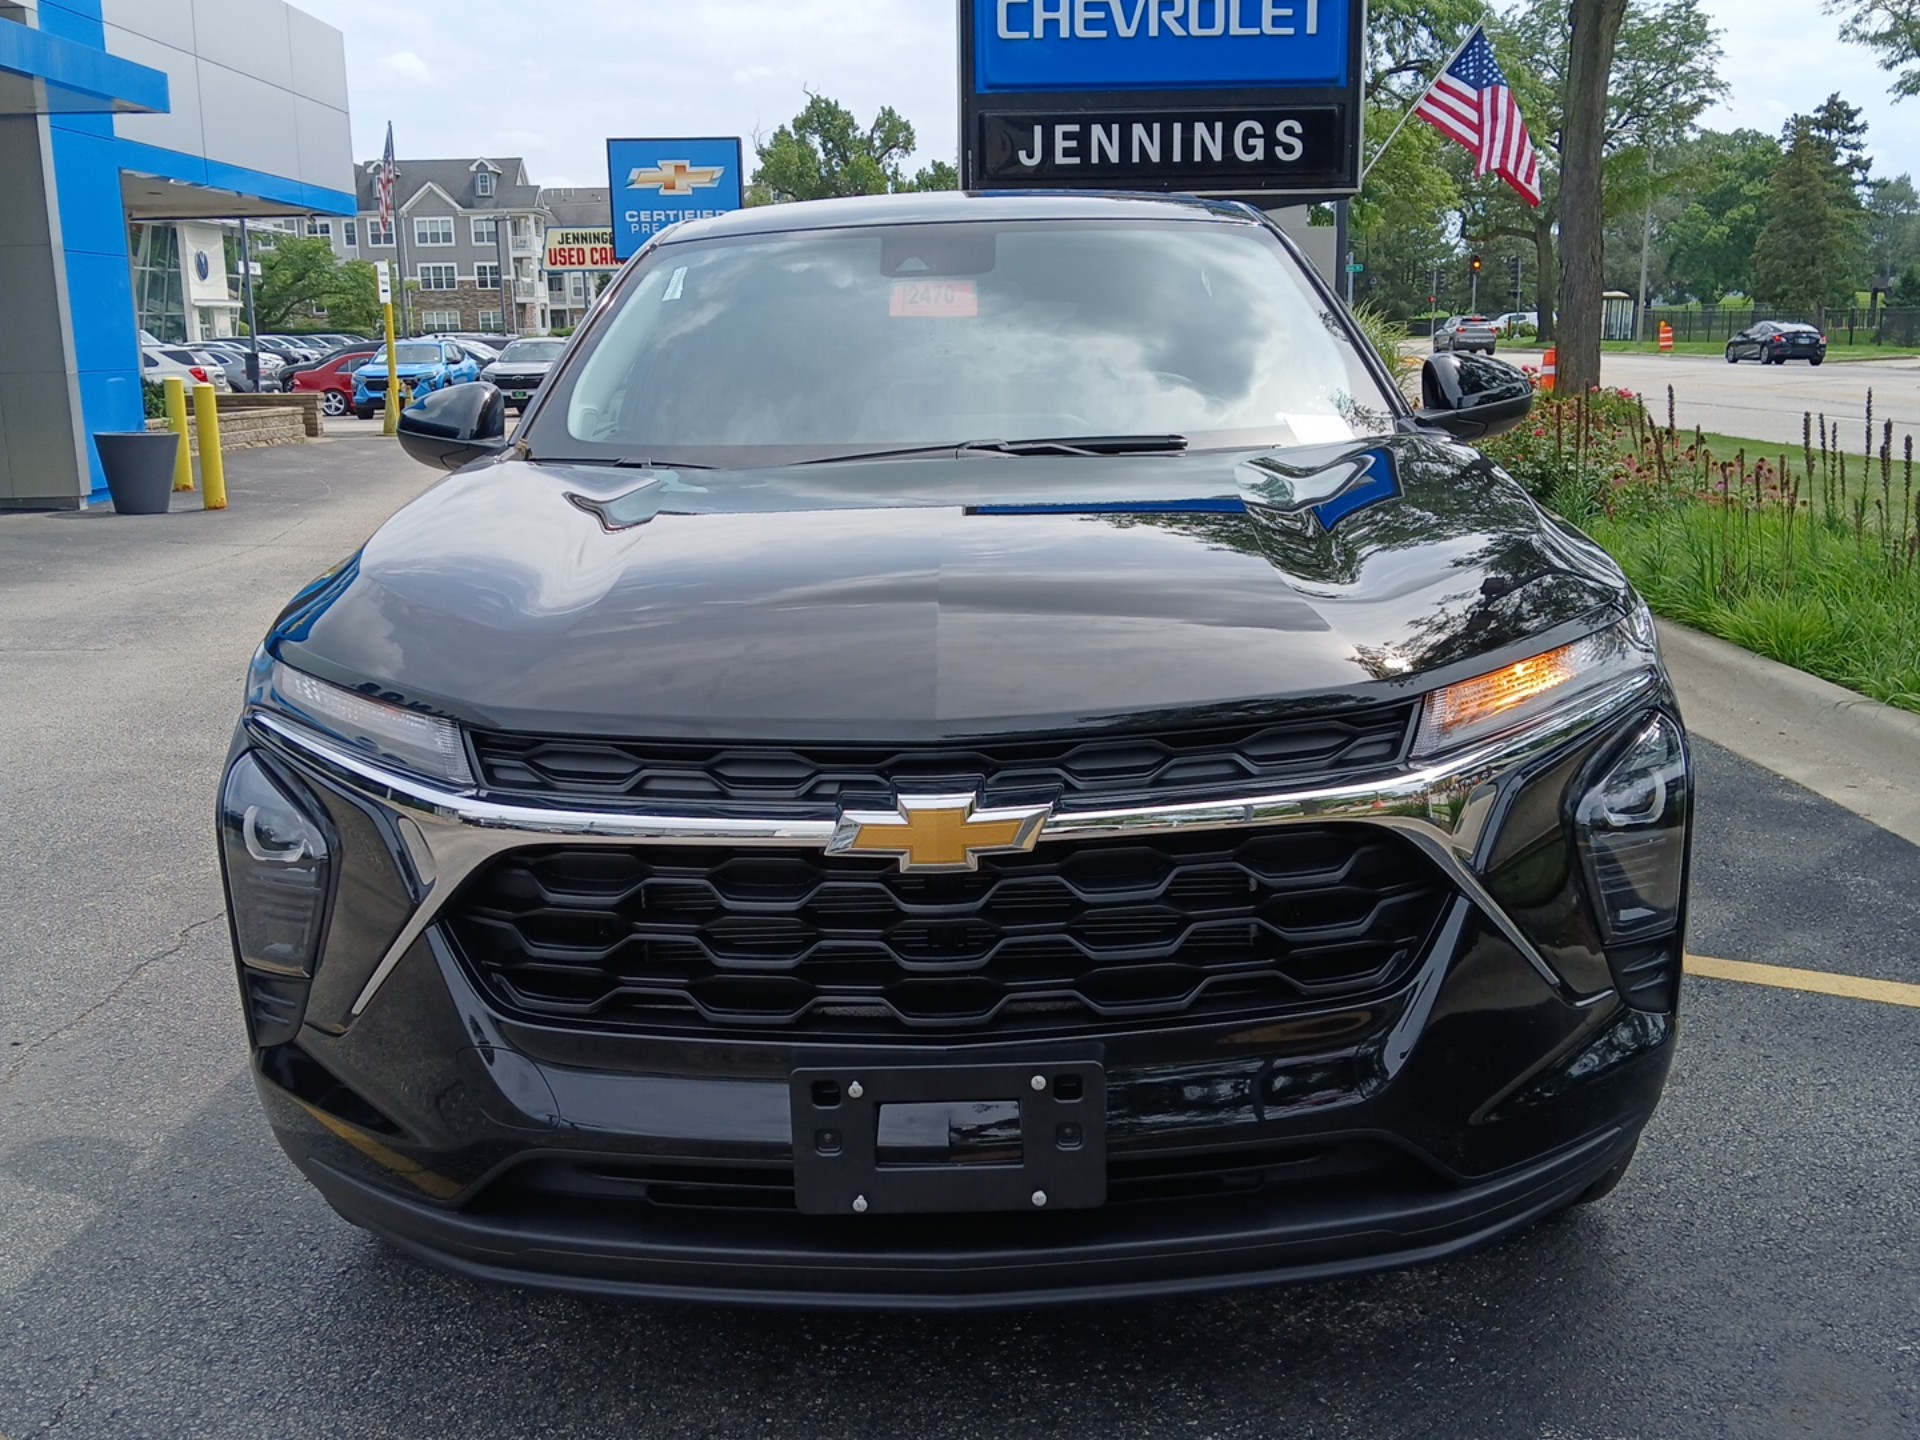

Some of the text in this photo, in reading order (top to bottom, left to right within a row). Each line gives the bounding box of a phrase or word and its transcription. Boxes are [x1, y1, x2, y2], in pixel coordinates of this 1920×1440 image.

[1018, 119, 1304, 166] JENNINGS
[548, 247, 586, 266] USED
[907, 284, 955, 305] 2470
